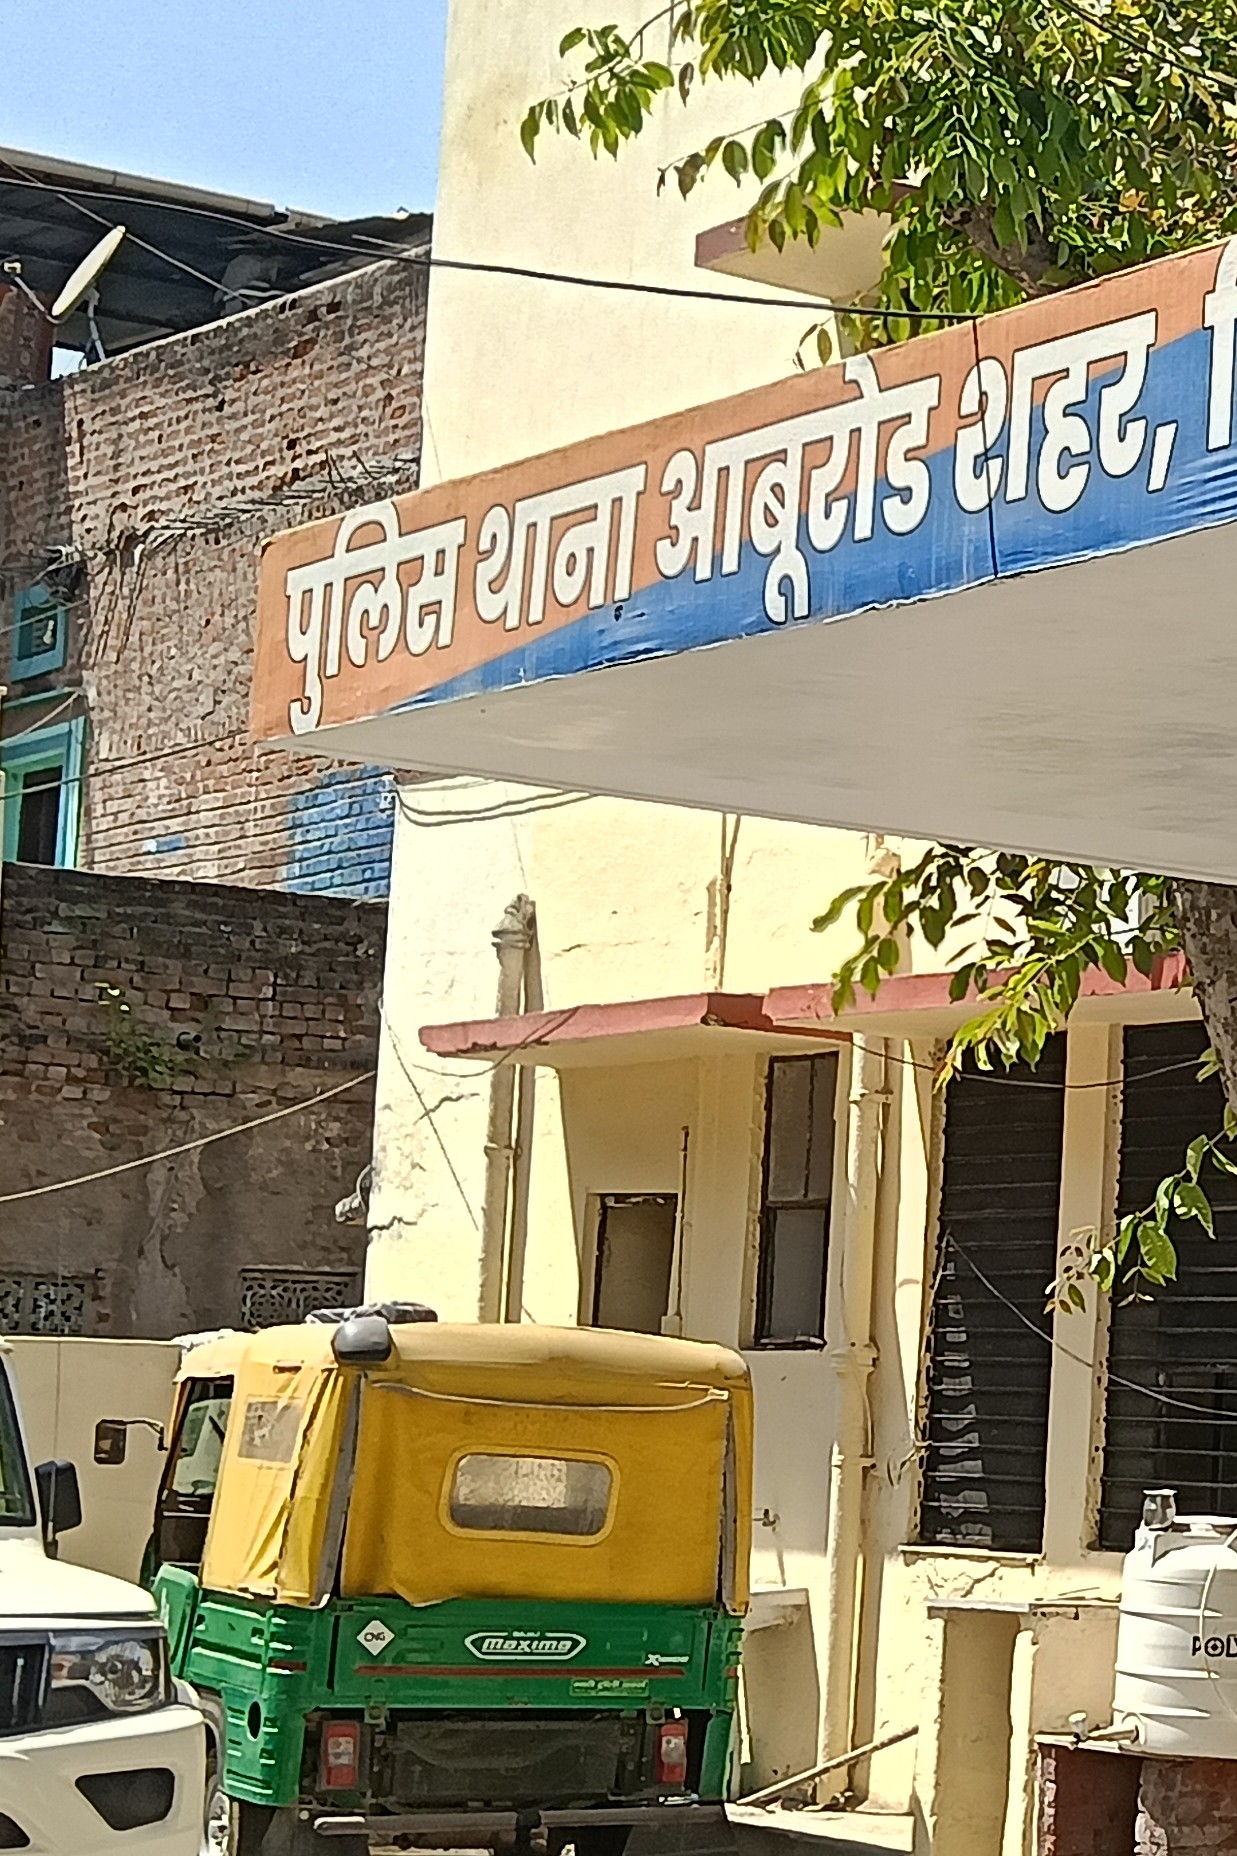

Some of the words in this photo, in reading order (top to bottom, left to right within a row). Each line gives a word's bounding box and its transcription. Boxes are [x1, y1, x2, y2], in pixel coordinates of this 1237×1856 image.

[285, 499, 466, 735] पुलिस
[475, 463, 647, 631] थाना
[655, 353, 941, 625] आबूरोड
[953, 308, 1178, 513] शहर,
[363, 1631, 386, 1643] CNG
